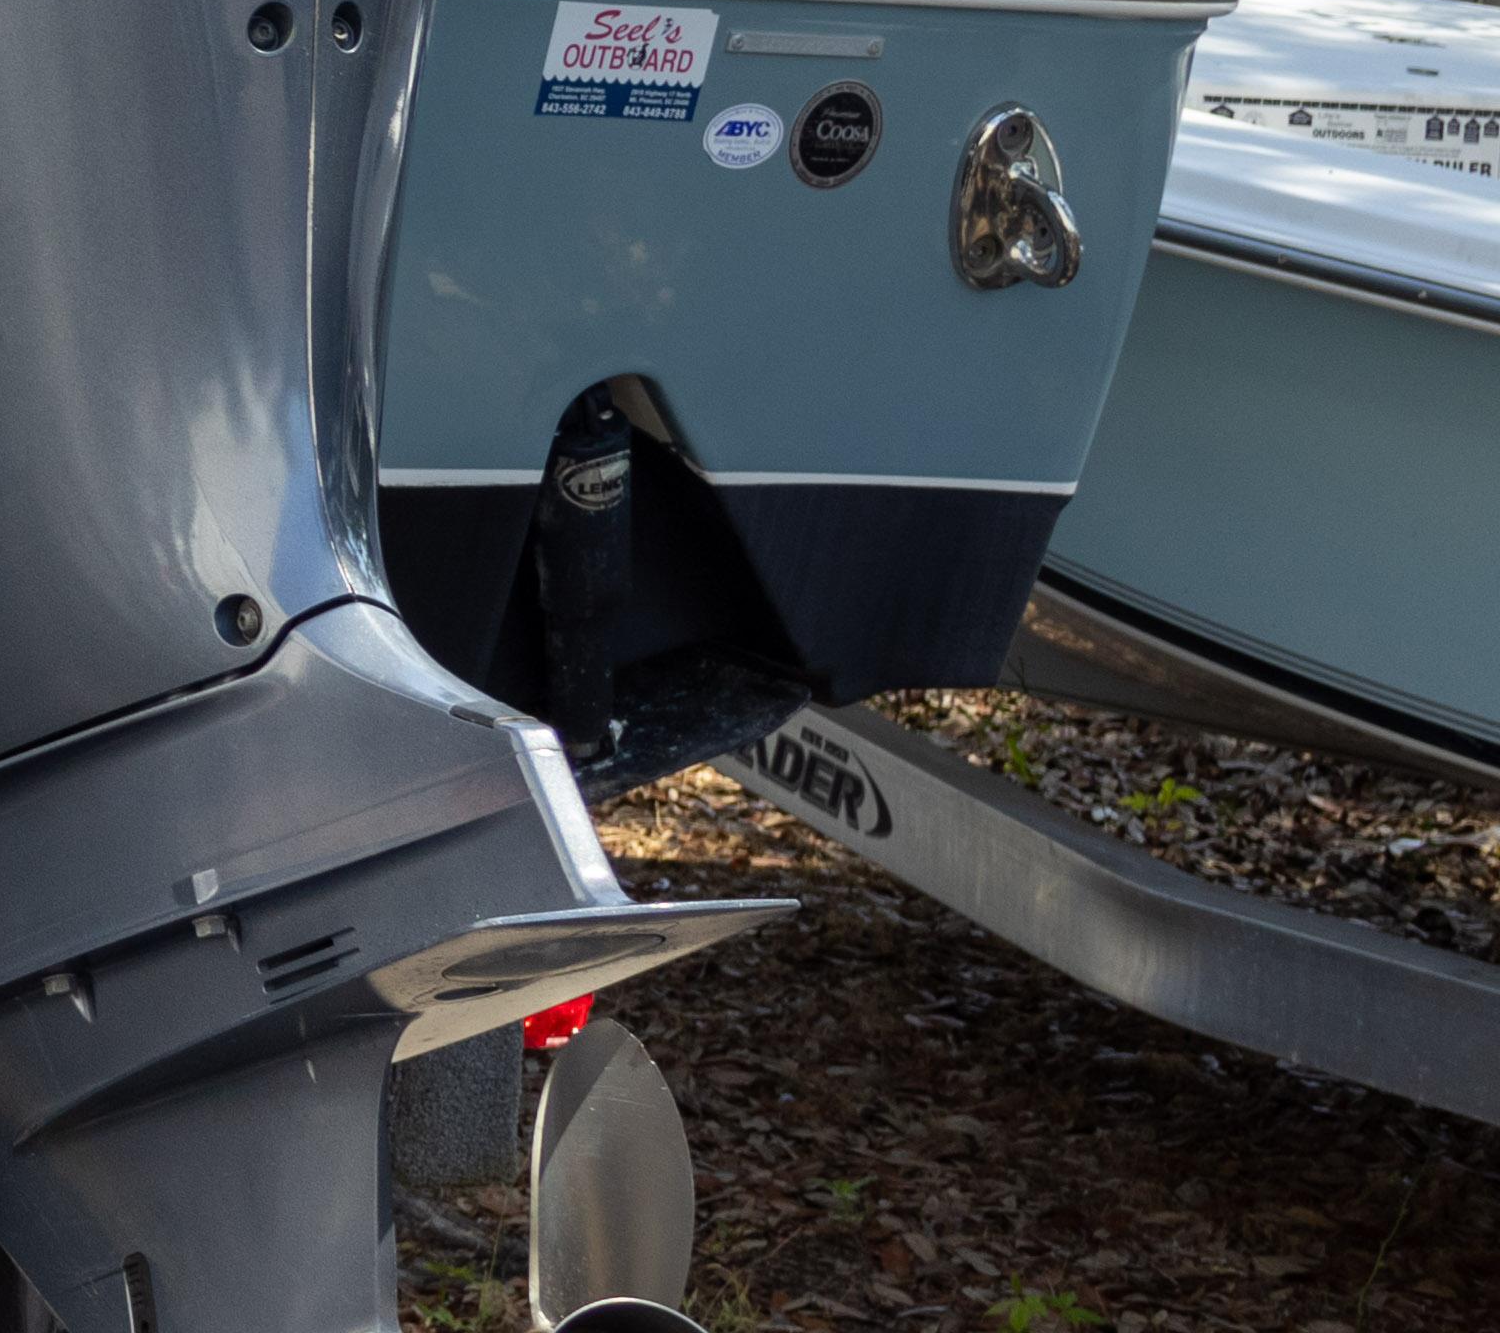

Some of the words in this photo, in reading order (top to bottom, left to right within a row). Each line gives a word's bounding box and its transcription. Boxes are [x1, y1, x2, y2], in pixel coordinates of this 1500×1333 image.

[585, 9, 682, 44] Seel's
[715, 120, 771, 138] ABYC
[1312, 128, 1365, 141] OUTDOORS
[578, 477, 622, 495] LENC
